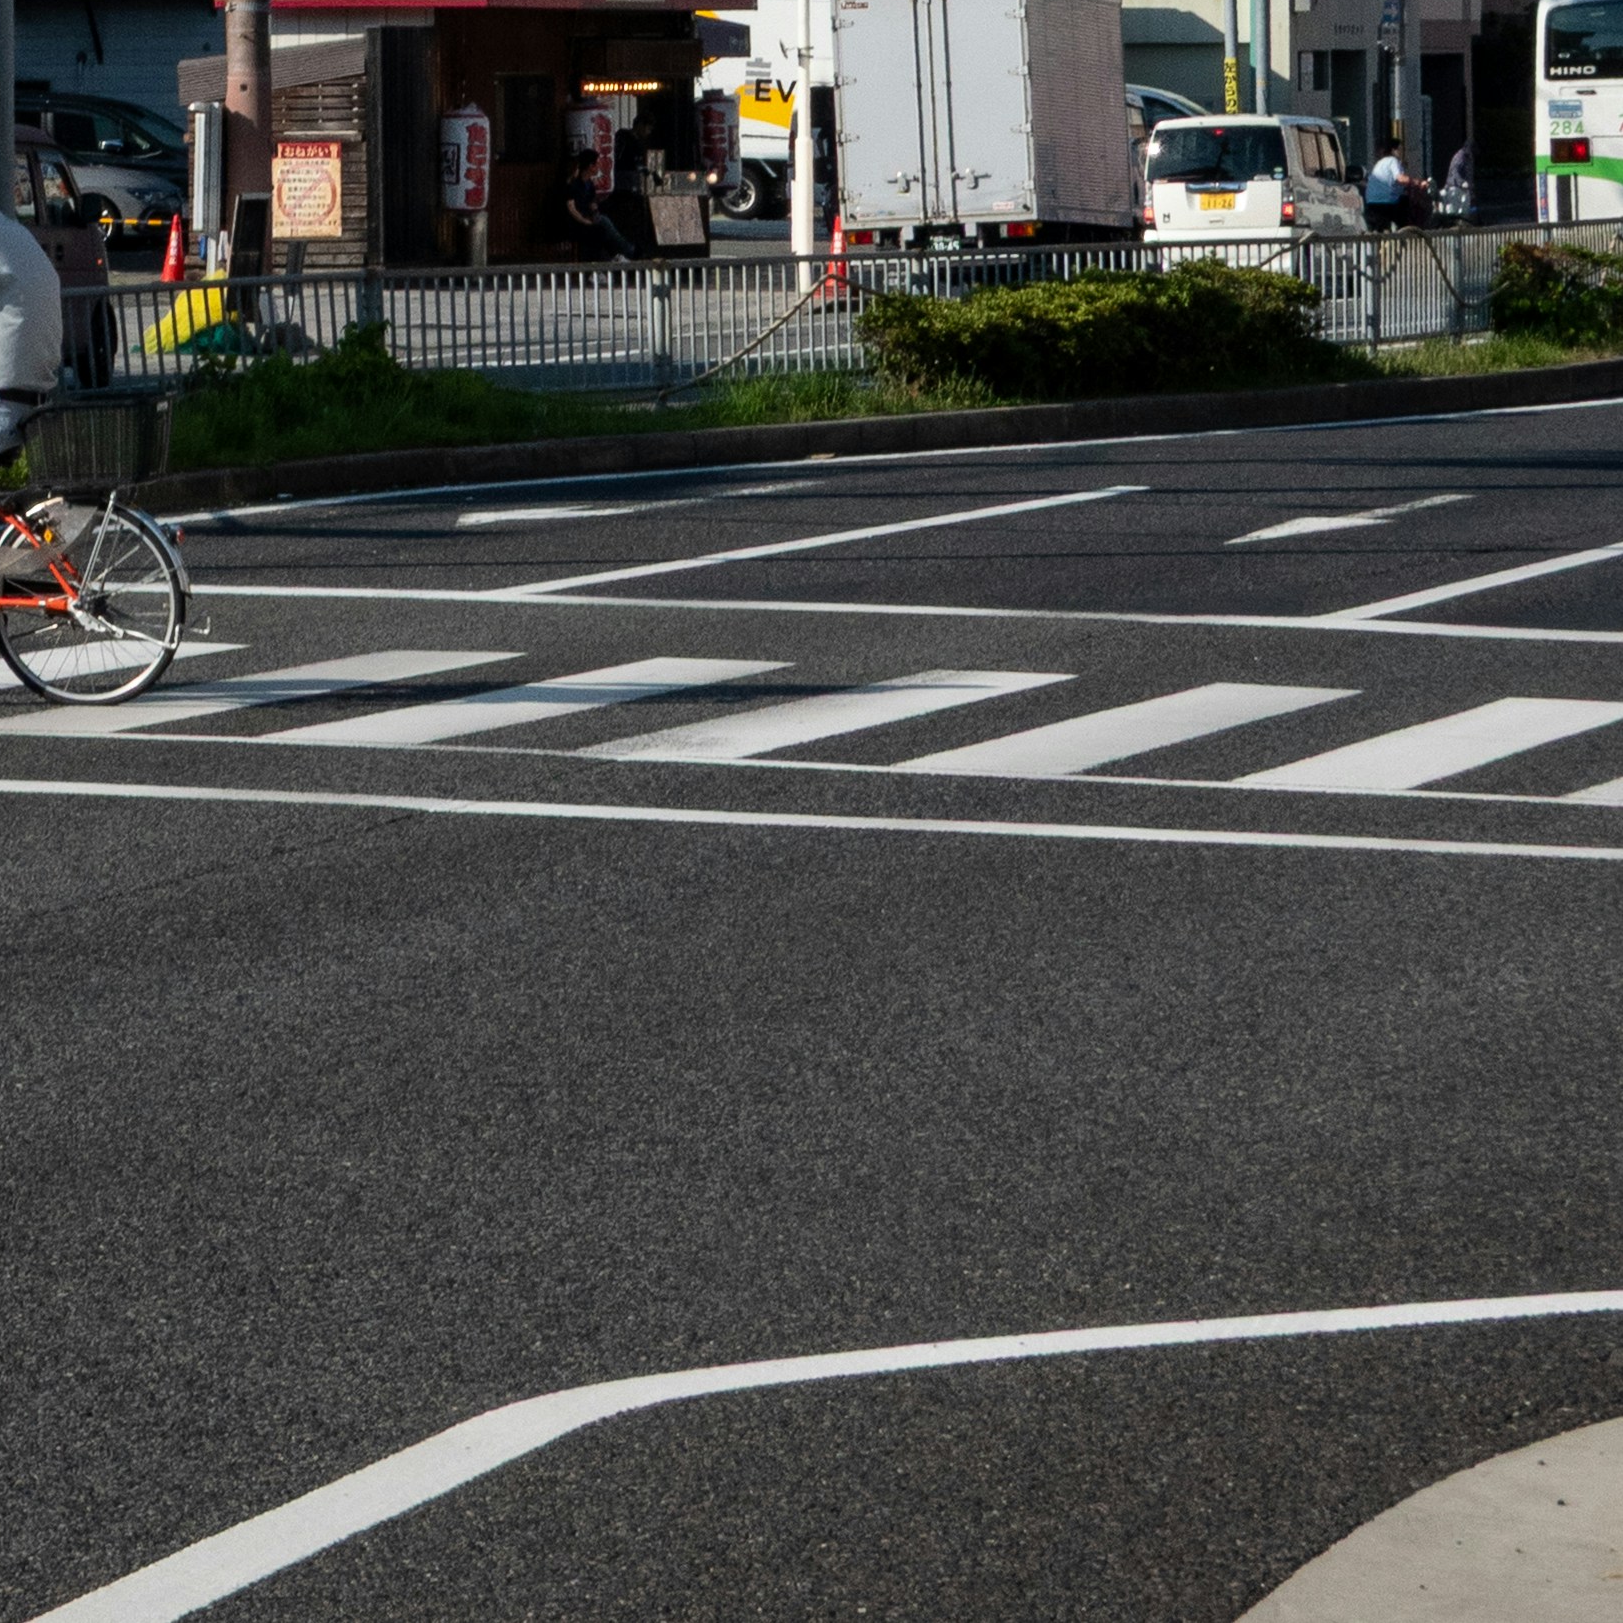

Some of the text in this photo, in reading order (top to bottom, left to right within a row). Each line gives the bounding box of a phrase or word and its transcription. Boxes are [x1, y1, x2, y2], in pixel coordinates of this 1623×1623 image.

[1550, 66, 1596, 76] HINO
[755, 79, 797, 102] EV
[1550, 121, 1584, 135] 284
